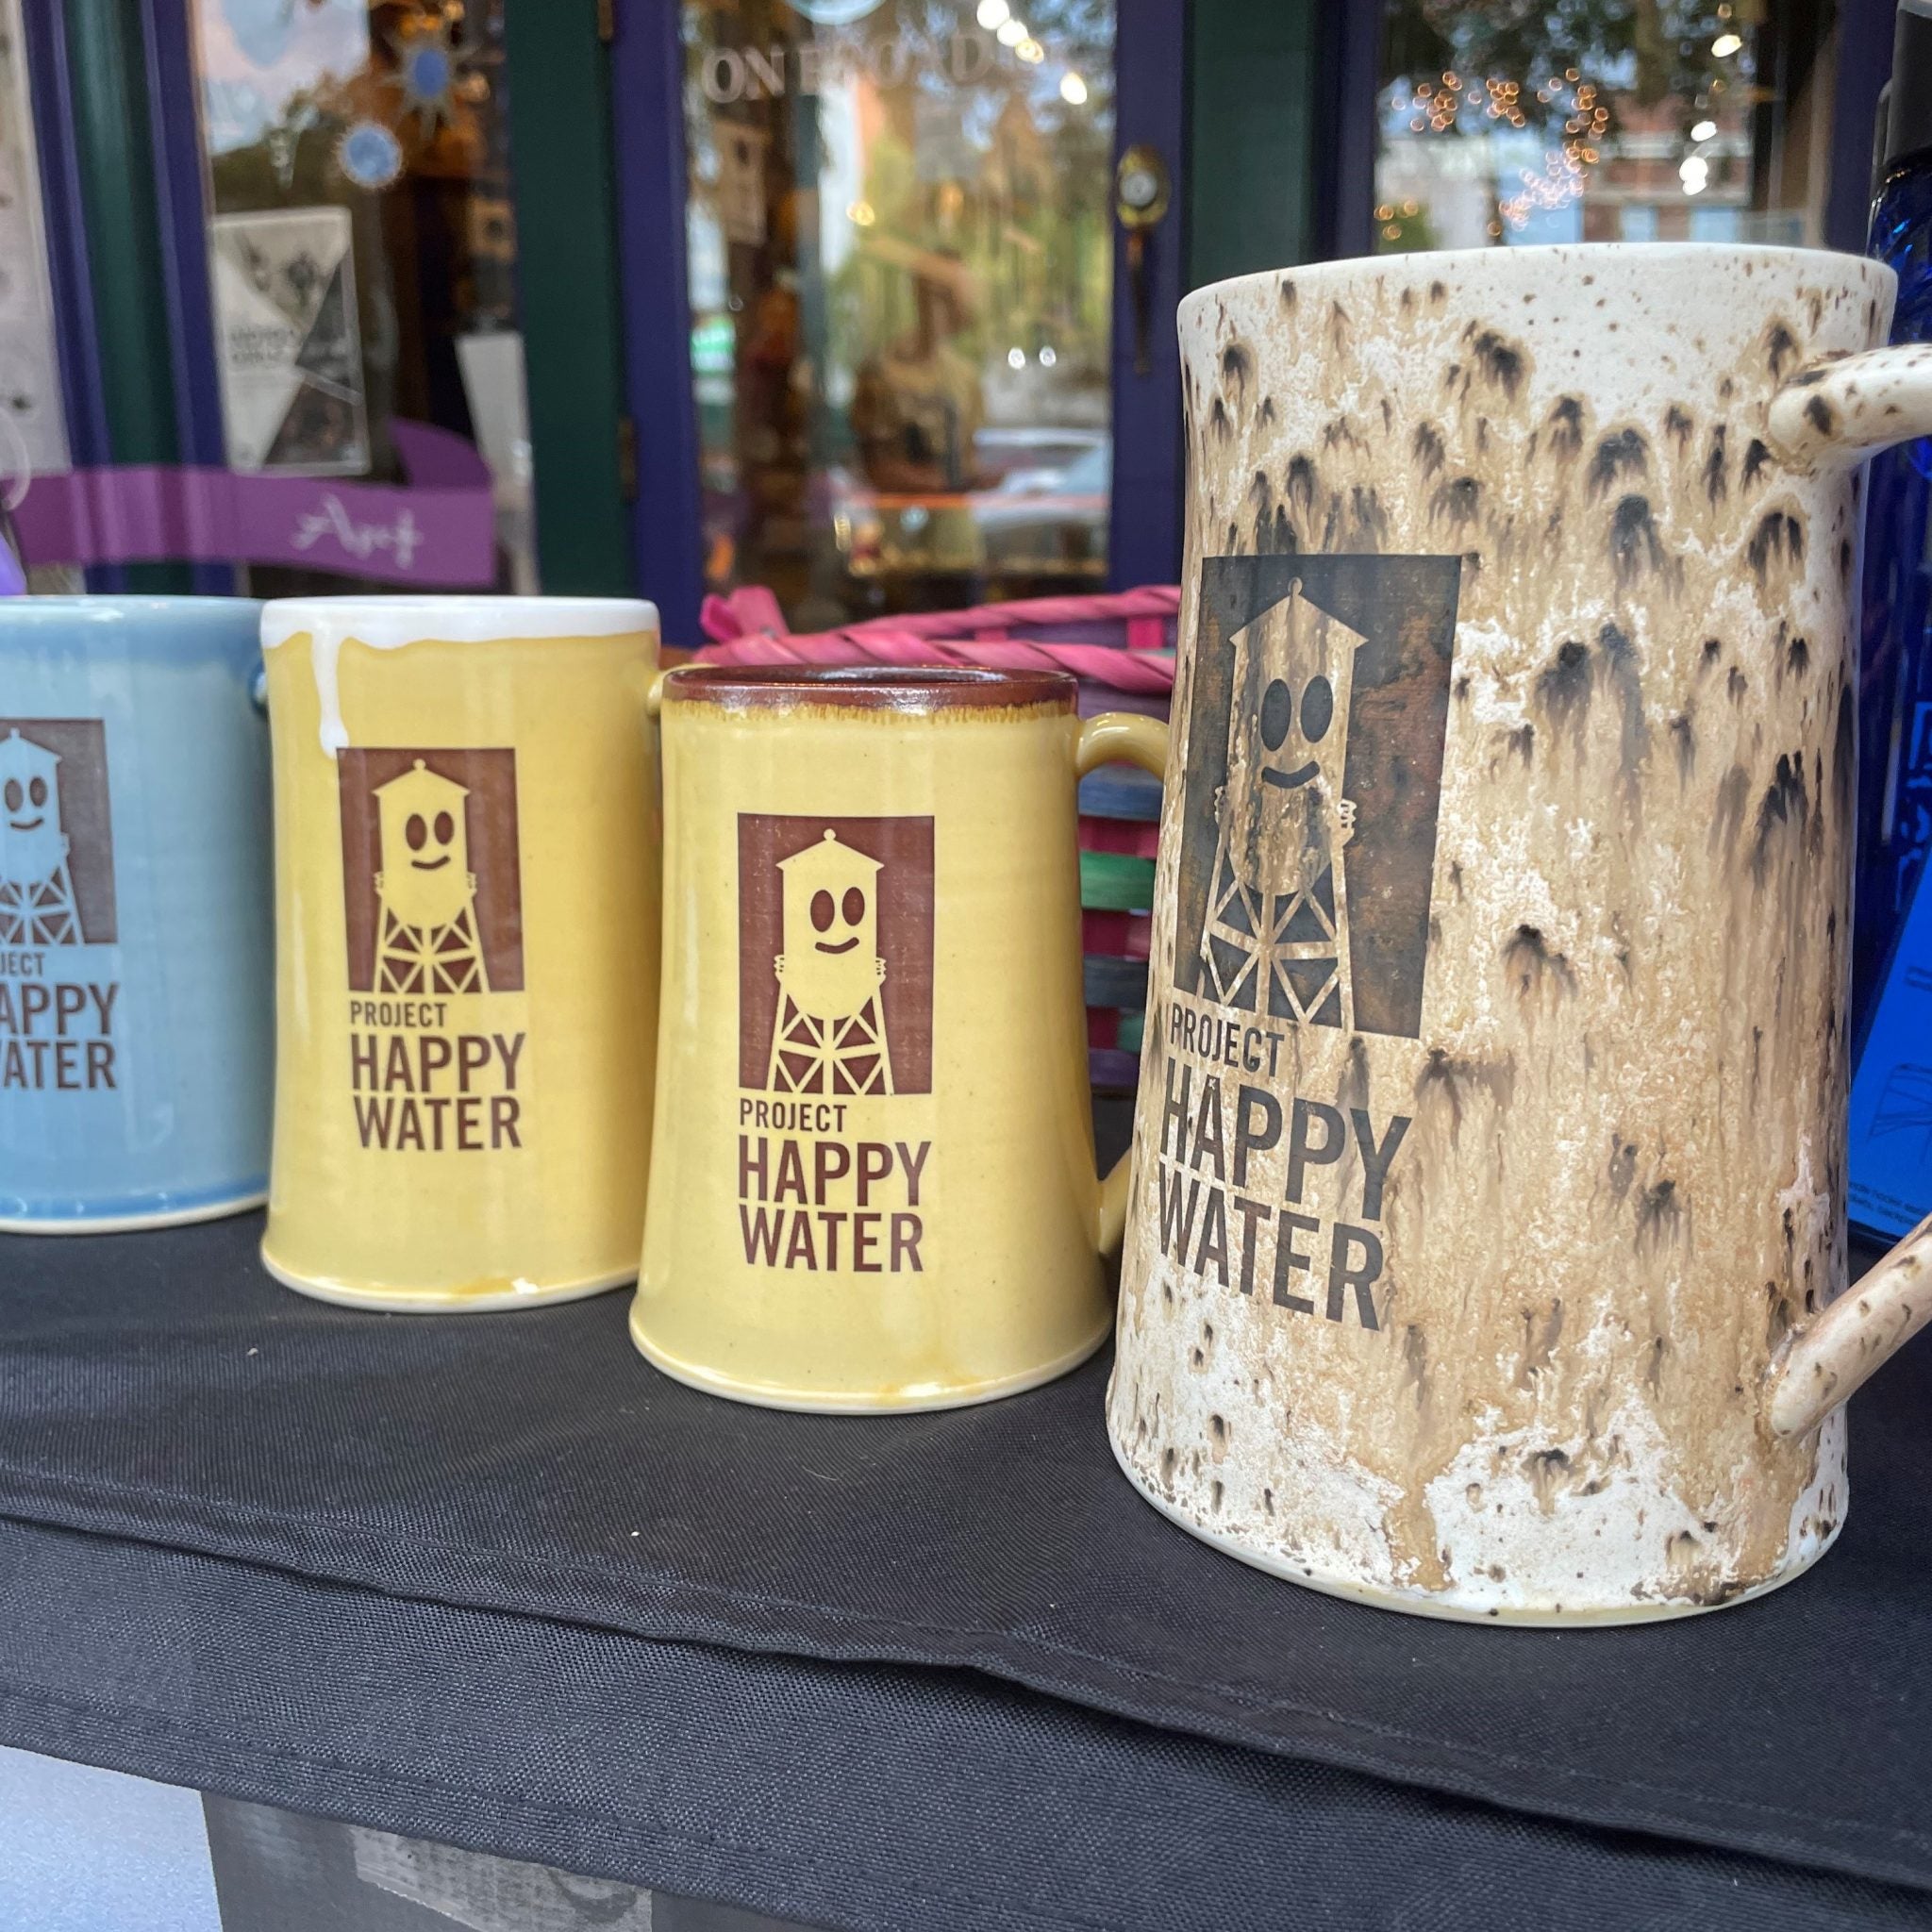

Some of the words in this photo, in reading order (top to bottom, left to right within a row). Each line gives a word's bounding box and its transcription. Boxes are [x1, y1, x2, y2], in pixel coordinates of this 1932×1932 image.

[701, 46, 786, 103] ON
[0, 951, 45, 976] JECT
[0, 983, 119, 1035] APPY
[350, 1000, 448, 1027] PROJECT
[0, 1041, 116, 1089] ATER
[351, 1033, 525, 1092] HAPPY
[1171, 1003, 1285, 1077] PROJECT
[354, 1096, 522, 1150] WATER
[740, 1098, 847, 1132] PROJECT
[1160, 1057, 1412, 1222] HAPPY
[739, 1134, 932, 1207] HAPPY
[739, 1204, 924, 1272] WATER
[1158, 1161, 1383, 1331] WATER
